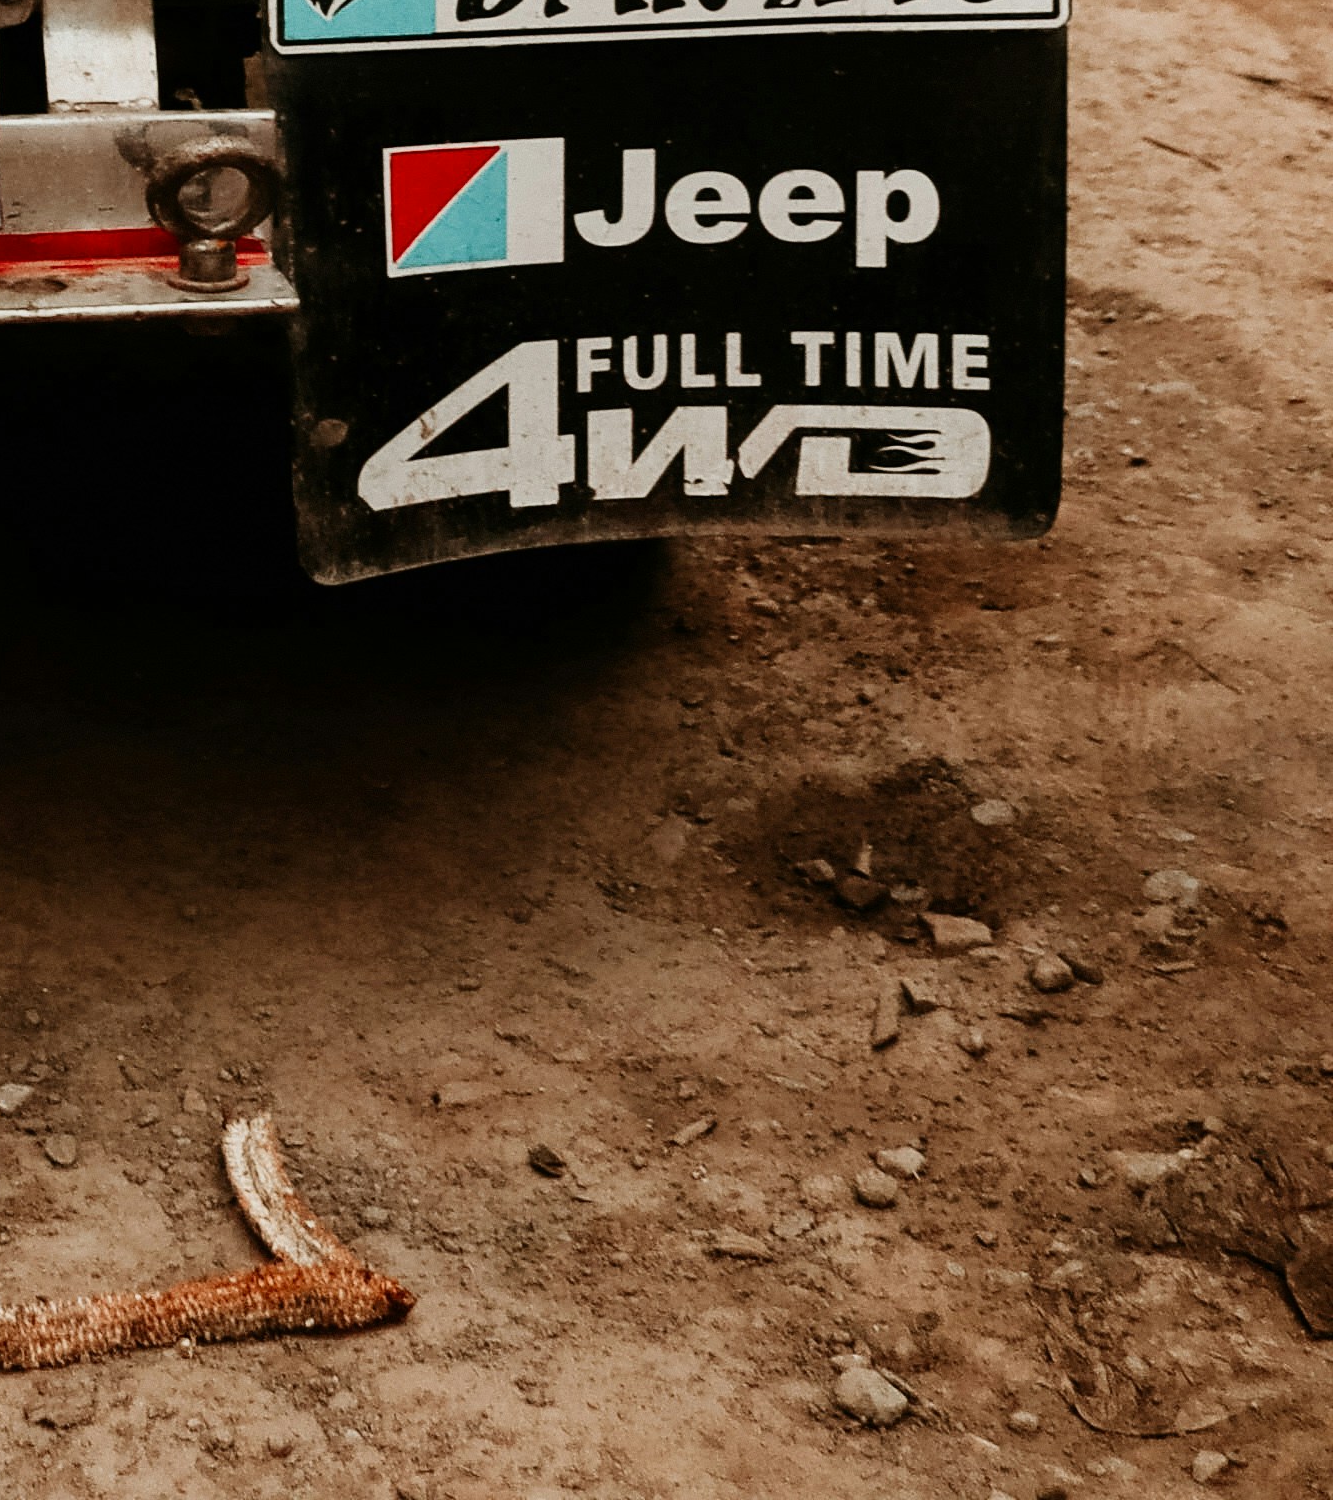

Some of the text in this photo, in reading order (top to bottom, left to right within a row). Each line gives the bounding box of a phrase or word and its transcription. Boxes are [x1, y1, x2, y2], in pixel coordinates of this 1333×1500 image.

[573, 147, 942, 269] Jeep
[575, 330, 992, 394] FULL TIME
[357, 338, 992, 512] 4WD
